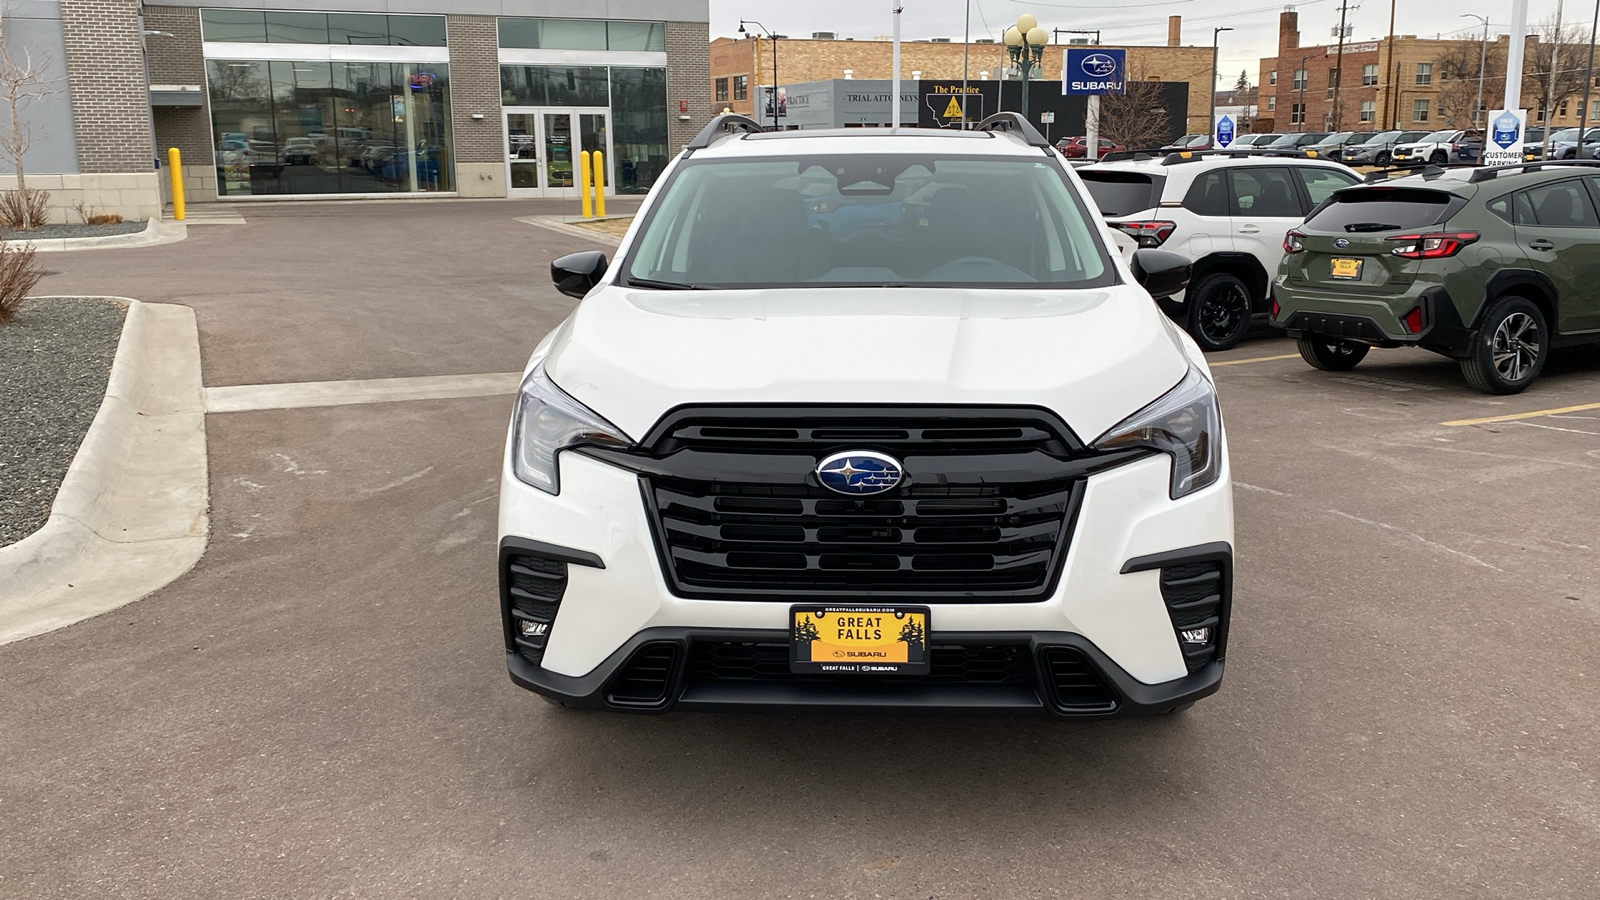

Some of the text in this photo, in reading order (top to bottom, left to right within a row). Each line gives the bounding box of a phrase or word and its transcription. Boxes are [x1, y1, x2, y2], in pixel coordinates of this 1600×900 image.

[933, 85, 979, 93] The Pratice
[1071, 81, 1121, 90] SUBARU
[787, 95, 809, 105] PRACTICE
[1486, 151, 1523, 159] CUSTOMER
[837, 617, 882, 628] GREAT
[837, 629, 882, 639] FALLS
